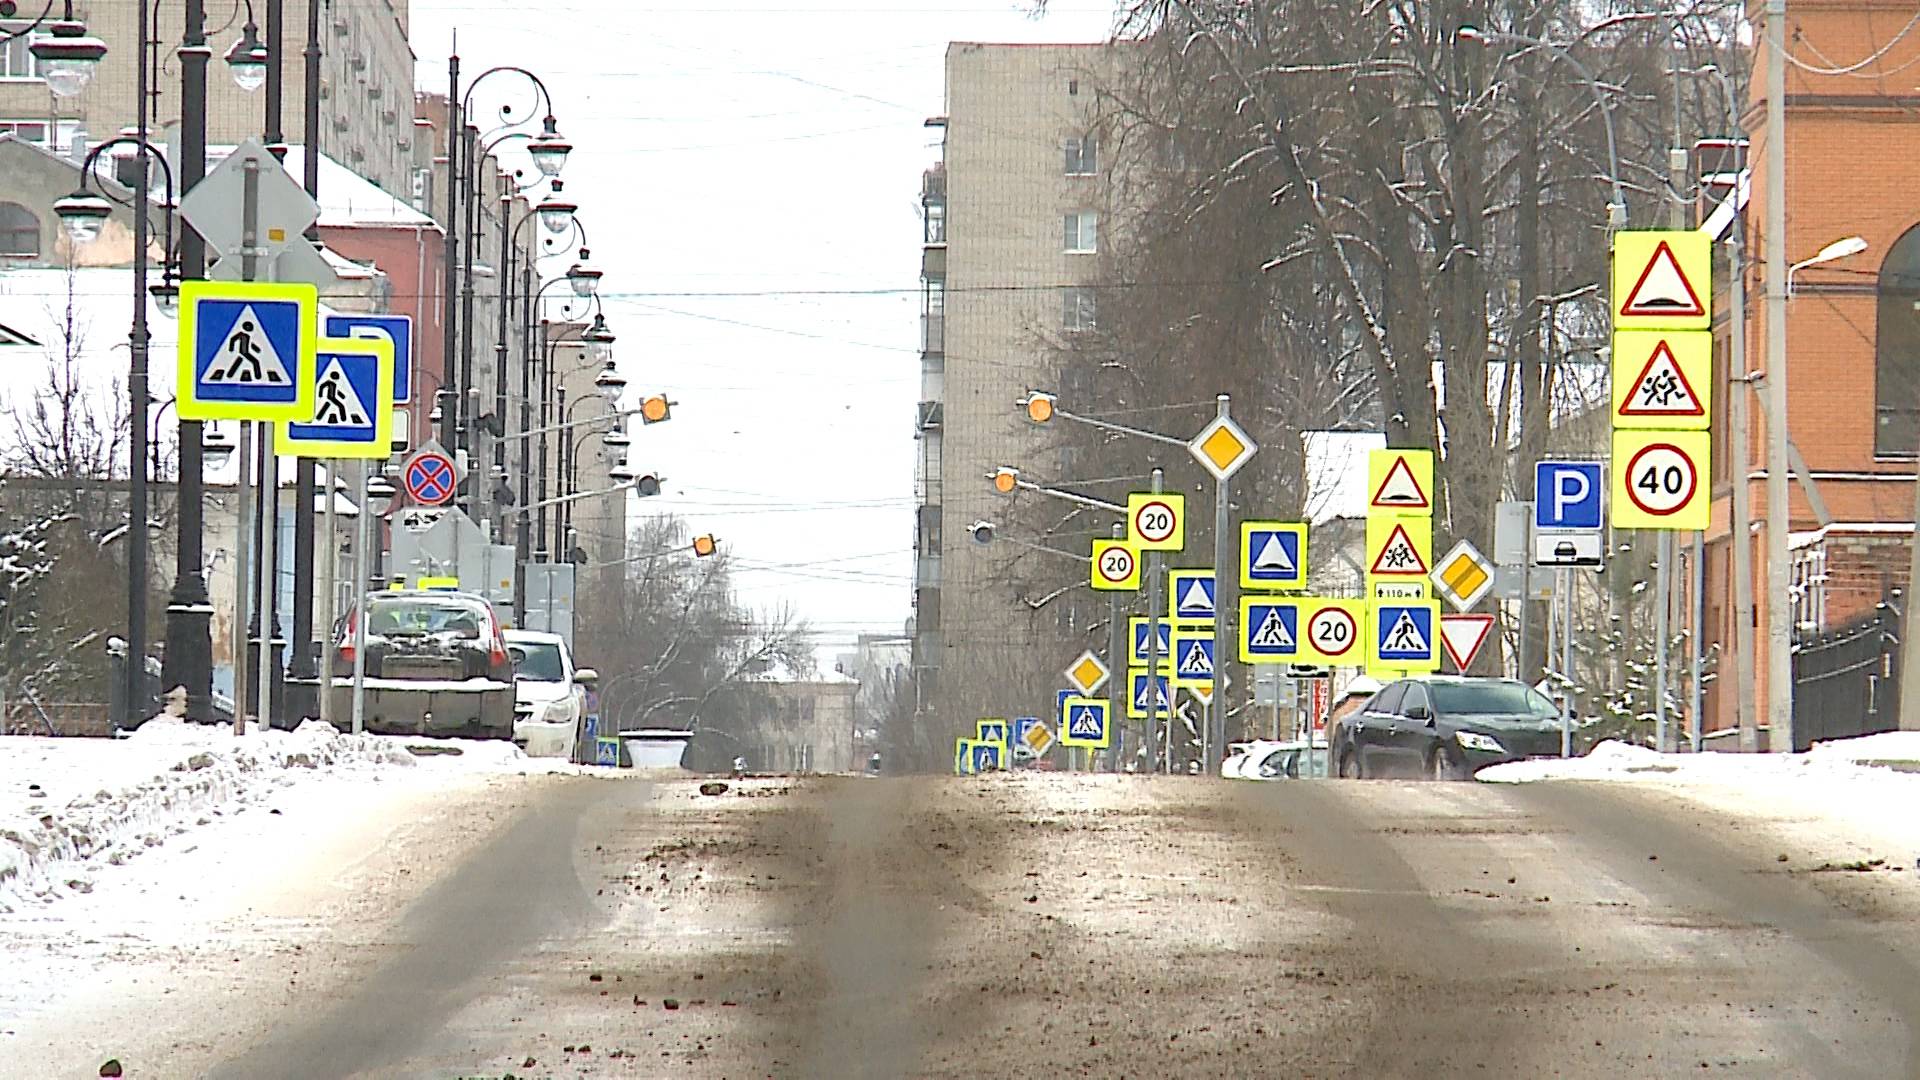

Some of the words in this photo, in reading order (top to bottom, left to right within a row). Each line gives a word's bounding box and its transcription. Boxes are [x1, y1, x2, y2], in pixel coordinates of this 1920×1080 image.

[1638, 465, 1683, 494] 40
[1554, 470, 1590, 521] P
[1145, 513, 1168, 530] 20
[1106, 557, 1127, 572] 20
[1386, 589, 1403, 598] 110
[1319, 621, 1347, 642] 20
